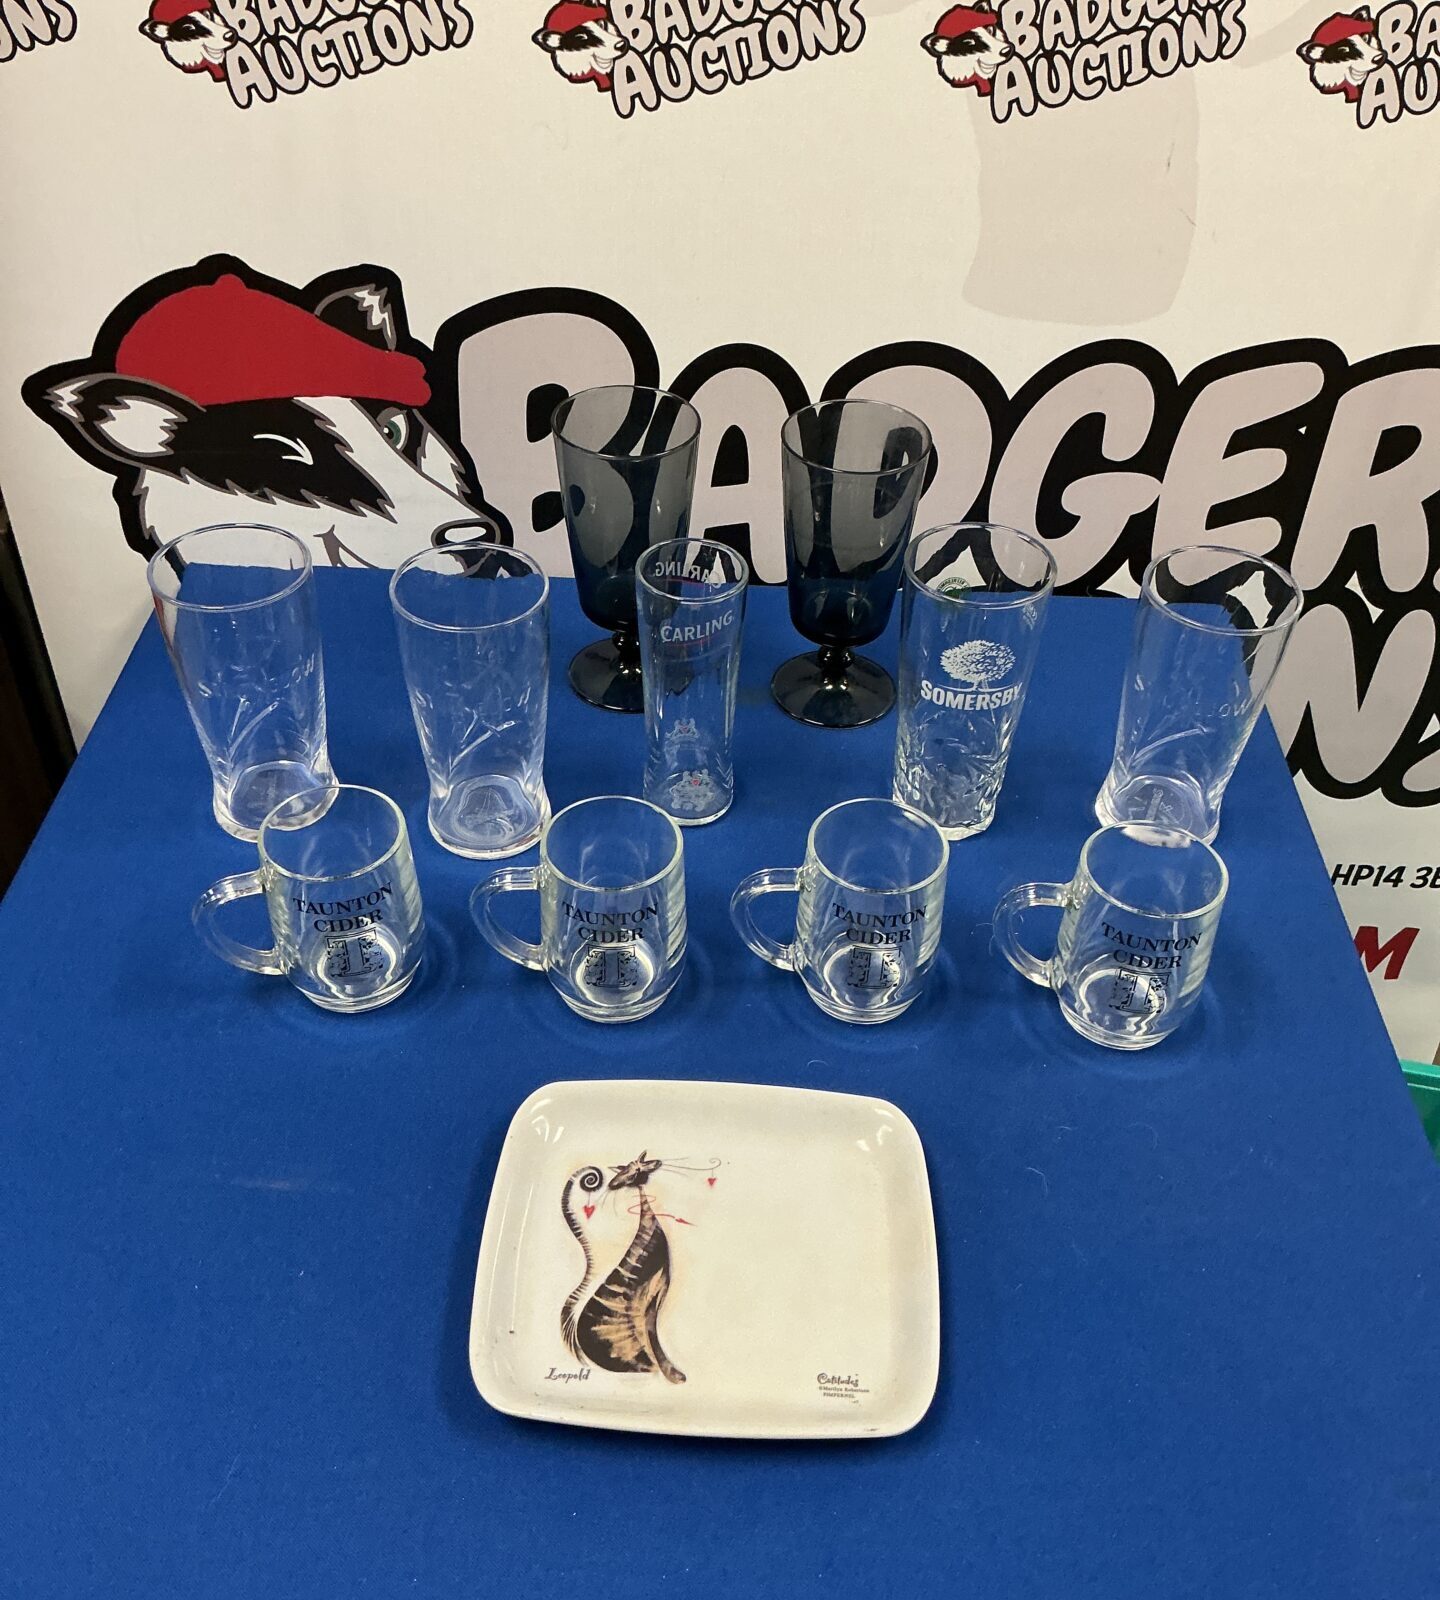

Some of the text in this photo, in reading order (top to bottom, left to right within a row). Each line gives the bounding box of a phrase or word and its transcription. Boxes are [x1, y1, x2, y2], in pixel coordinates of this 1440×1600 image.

[226, 0, 473, 109] AUCTIONS
[611, 0, 866, 119] AUCTIONS
[991, 0, 1247, 123] AUCTIONS
[434, 285, 1440, 600] BADGER
[660, 610, 733, 643] CARLING
[920, 679, 1023, 711] SOMERSBY
[1330, 863, 1406, 888] HP14
[293, 881, 393, 916] TAUNTON
[313, 909, 383, 933] CIDER
[562, 902, 658, 926] TAUNTON
[832, 903, 928, 928] TAUNTON
[577, 926, 645, 944] CIDER
[846, 928, 911, 945] CIDER
[1101, 921, 1203, 952] TAUNTON
[1113, 948, 1182, 970] CIDER
[544, 1367, 591, 1384] Leopold
